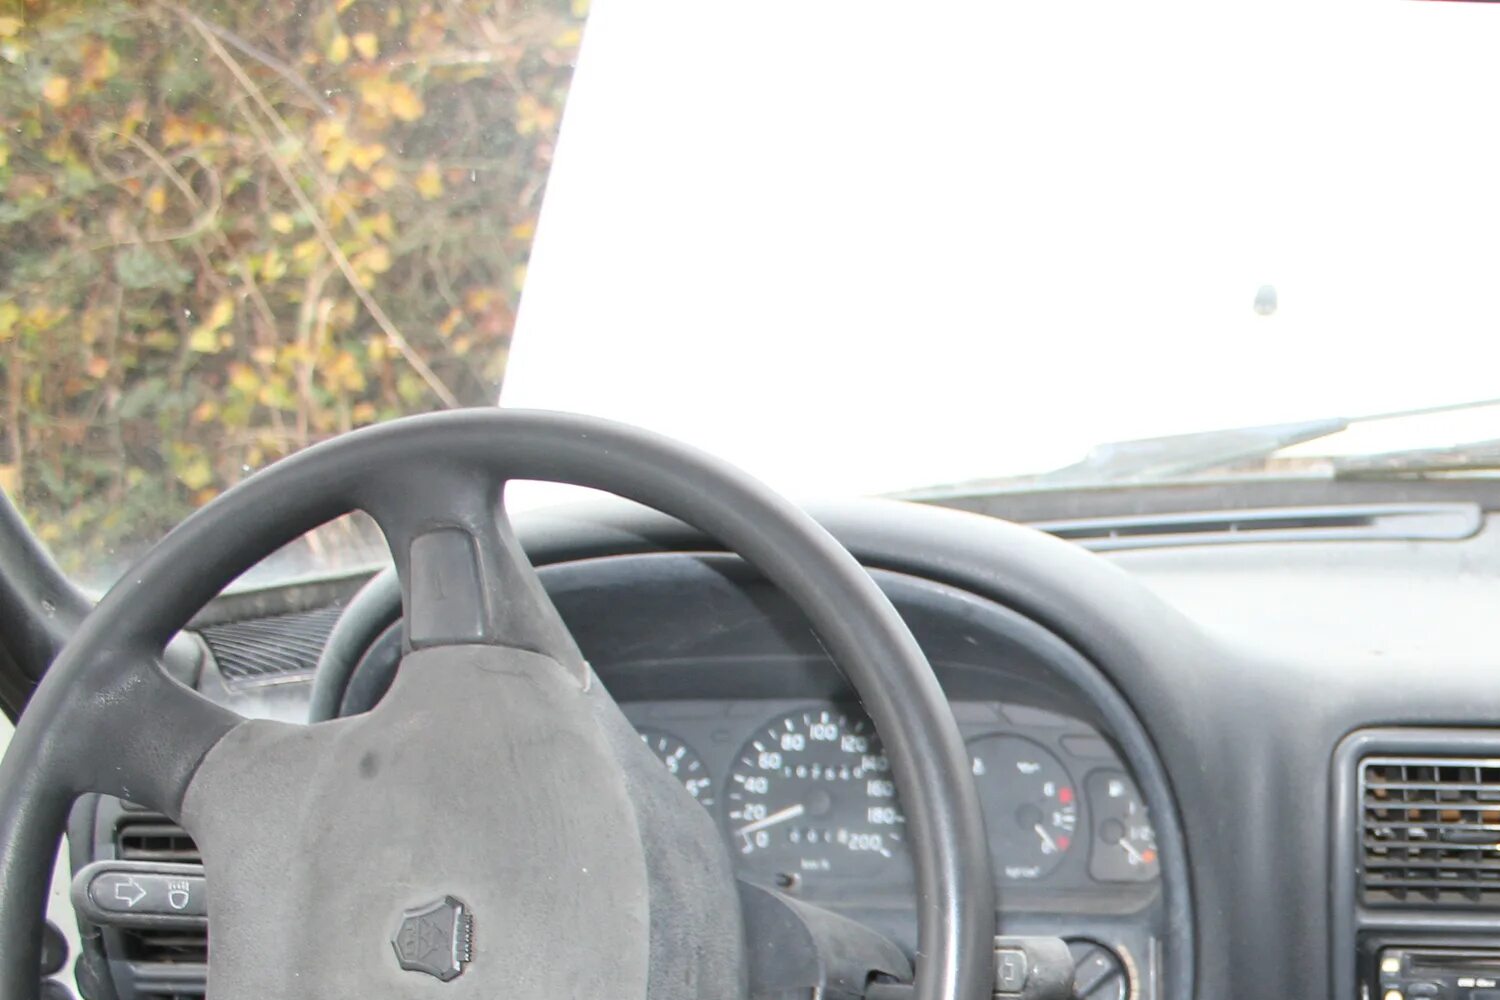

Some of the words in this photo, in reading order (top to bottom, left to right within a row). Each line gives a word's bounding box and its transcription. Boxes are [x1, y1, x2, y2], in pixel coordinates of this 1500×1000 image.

[809, 723, 838, 741] 100
[780, 733, 805, 751] 80
[841, 735, 867, 752] 120
[758, 752, 782, 769] 60
[862, 755, 888, 771] 140
[744, 776, 768, 794] 40
[867, 780, 893, 797] 160
[743, 803, 767, 821] 20
[868, 807, 896, 824] 180
[755, 830, 769, 848] 0
[848, 833, 882, 850] 200
